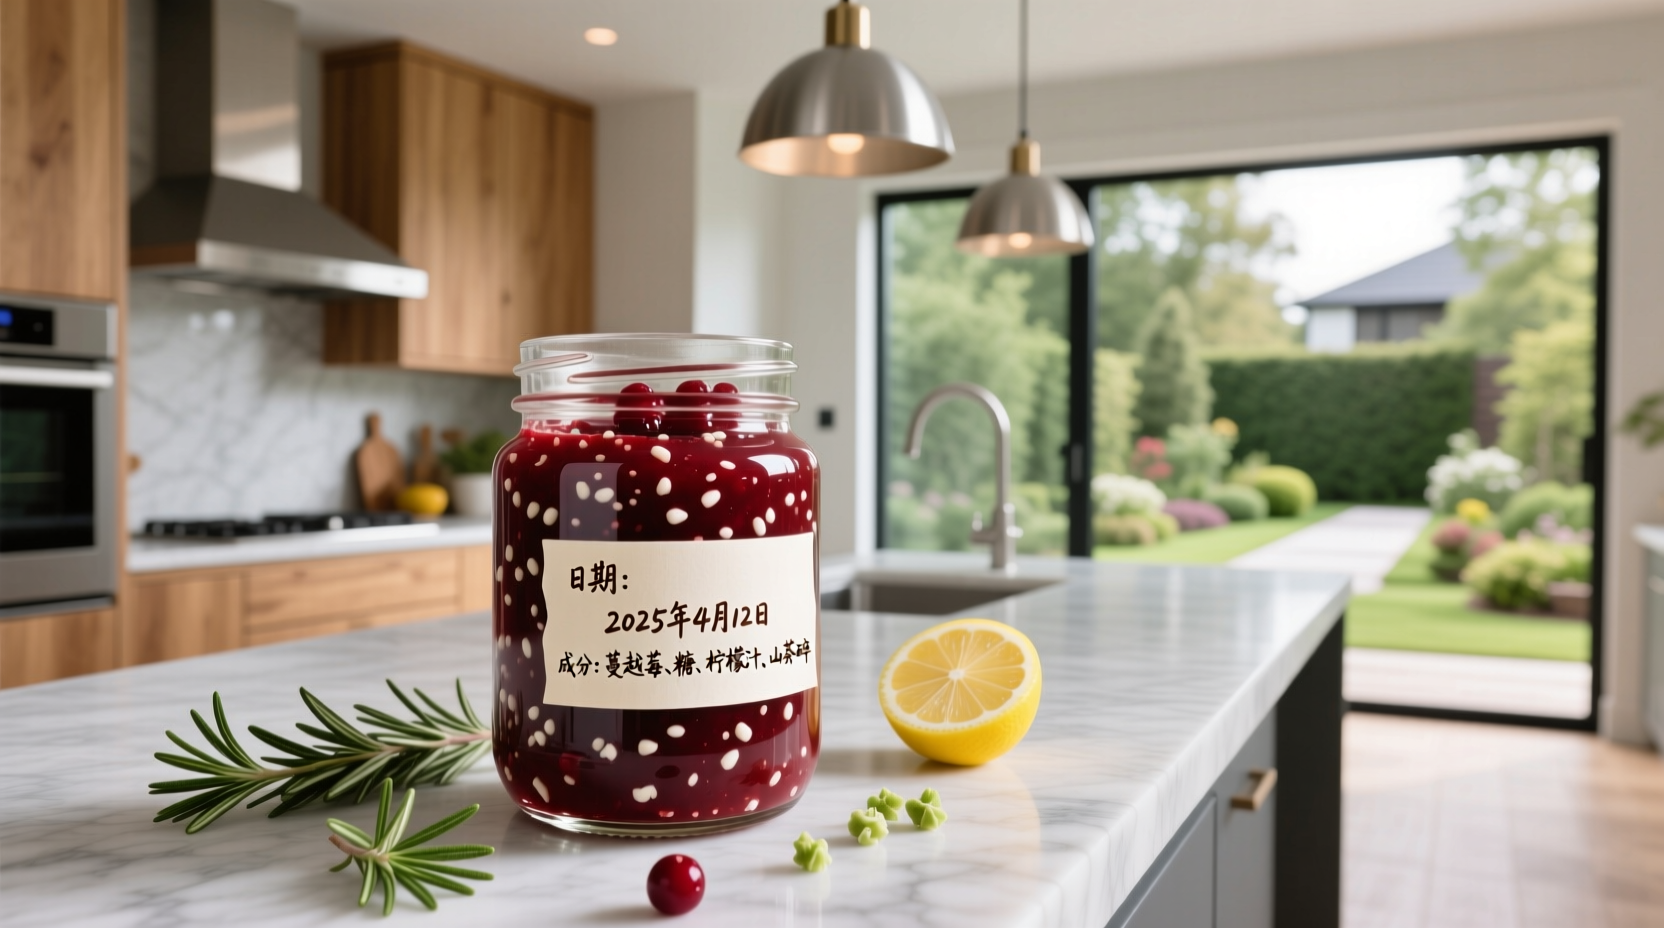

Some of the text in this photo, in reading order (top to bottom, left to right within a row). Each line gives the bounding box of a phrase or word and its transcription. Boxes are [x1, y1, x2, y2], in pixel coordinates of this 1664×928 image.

[570, 560, 628, 594] 日期：
[604, 601, 768, 638] 2025年4月12日
